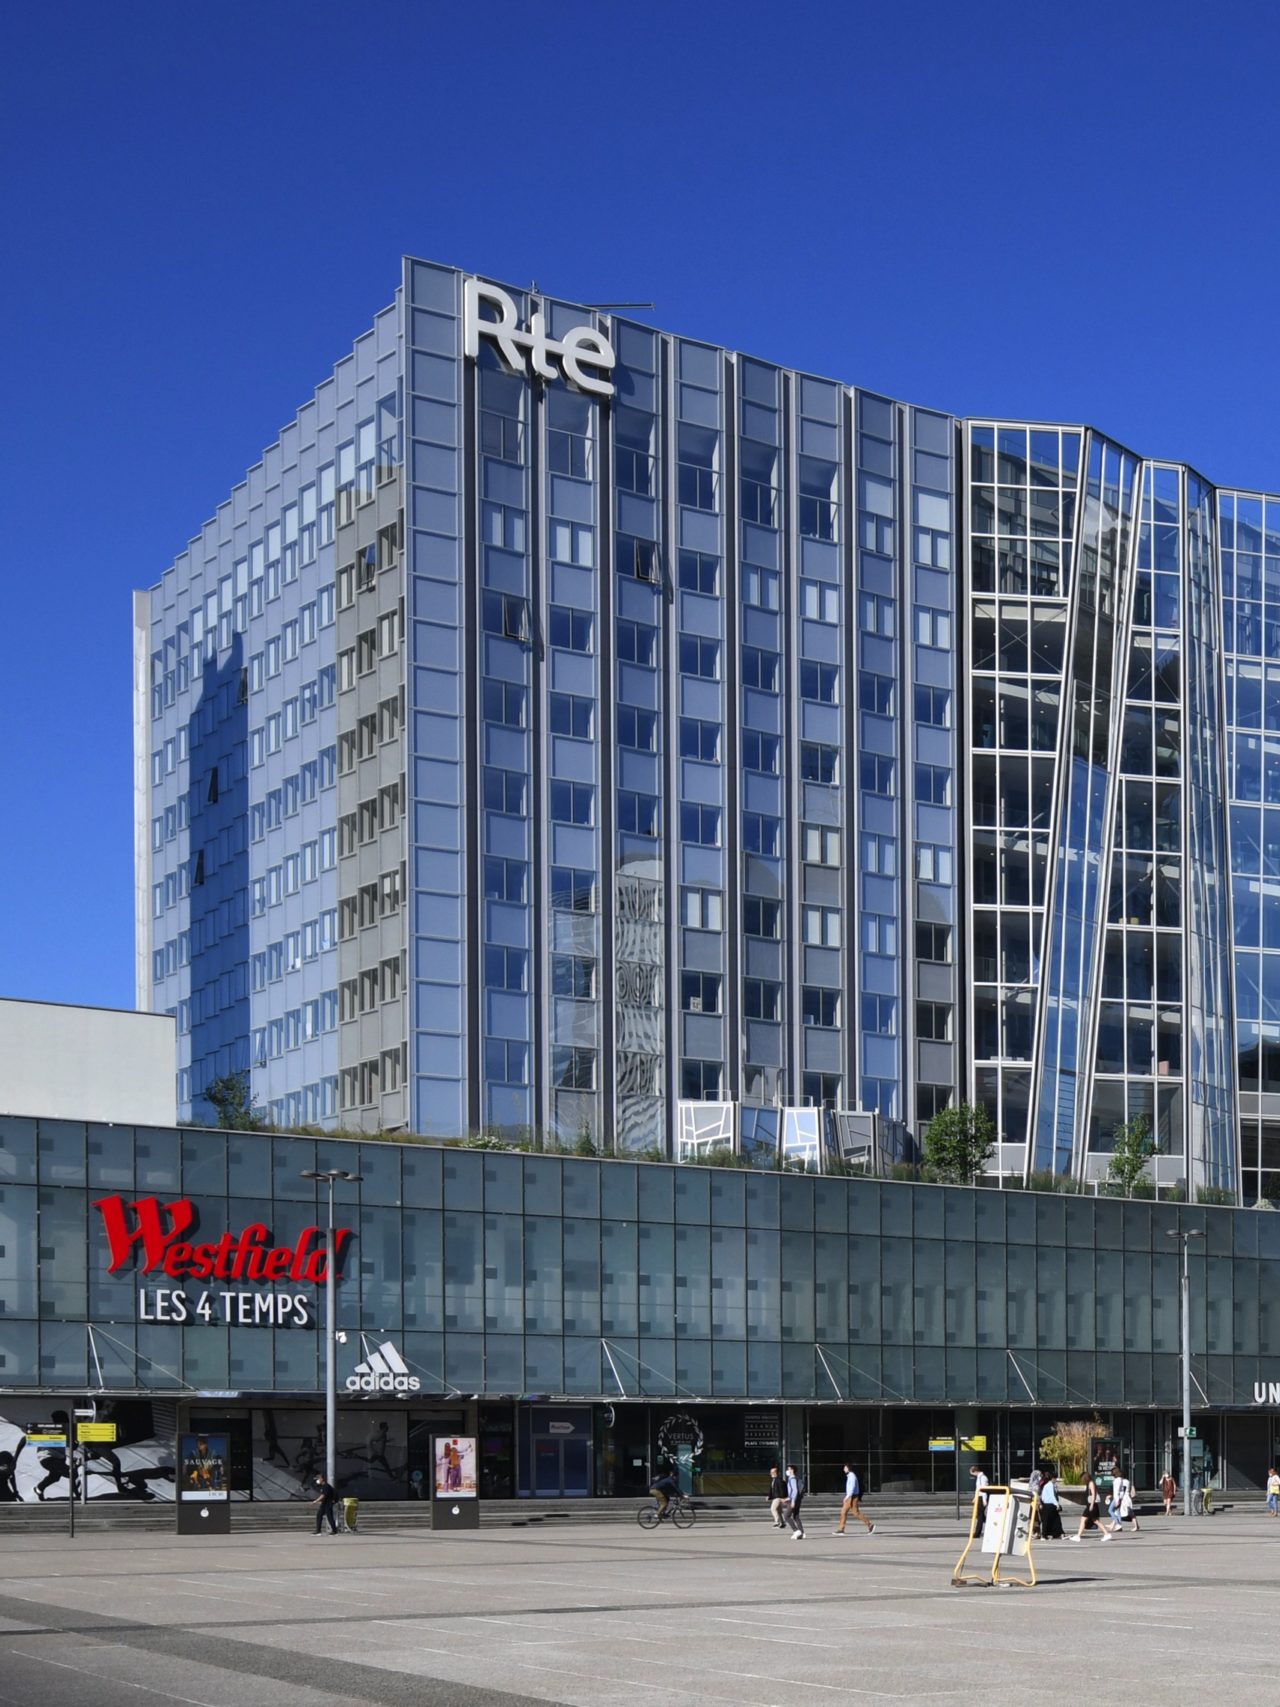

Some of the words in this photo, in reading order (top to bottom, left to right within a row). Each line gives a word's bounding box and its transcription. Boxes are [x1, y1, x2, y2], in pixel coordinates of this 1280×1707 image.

[464, 279, 615, 395] Rte
[92, 1195, 352, 1281] Westfield
[140, 1289, 187, 1322] LES
[196, 1291, 212, 1321] 4
[220, 1292, 308, 1325] TEMPS
[346, 1372, 420, 1390] adidas
